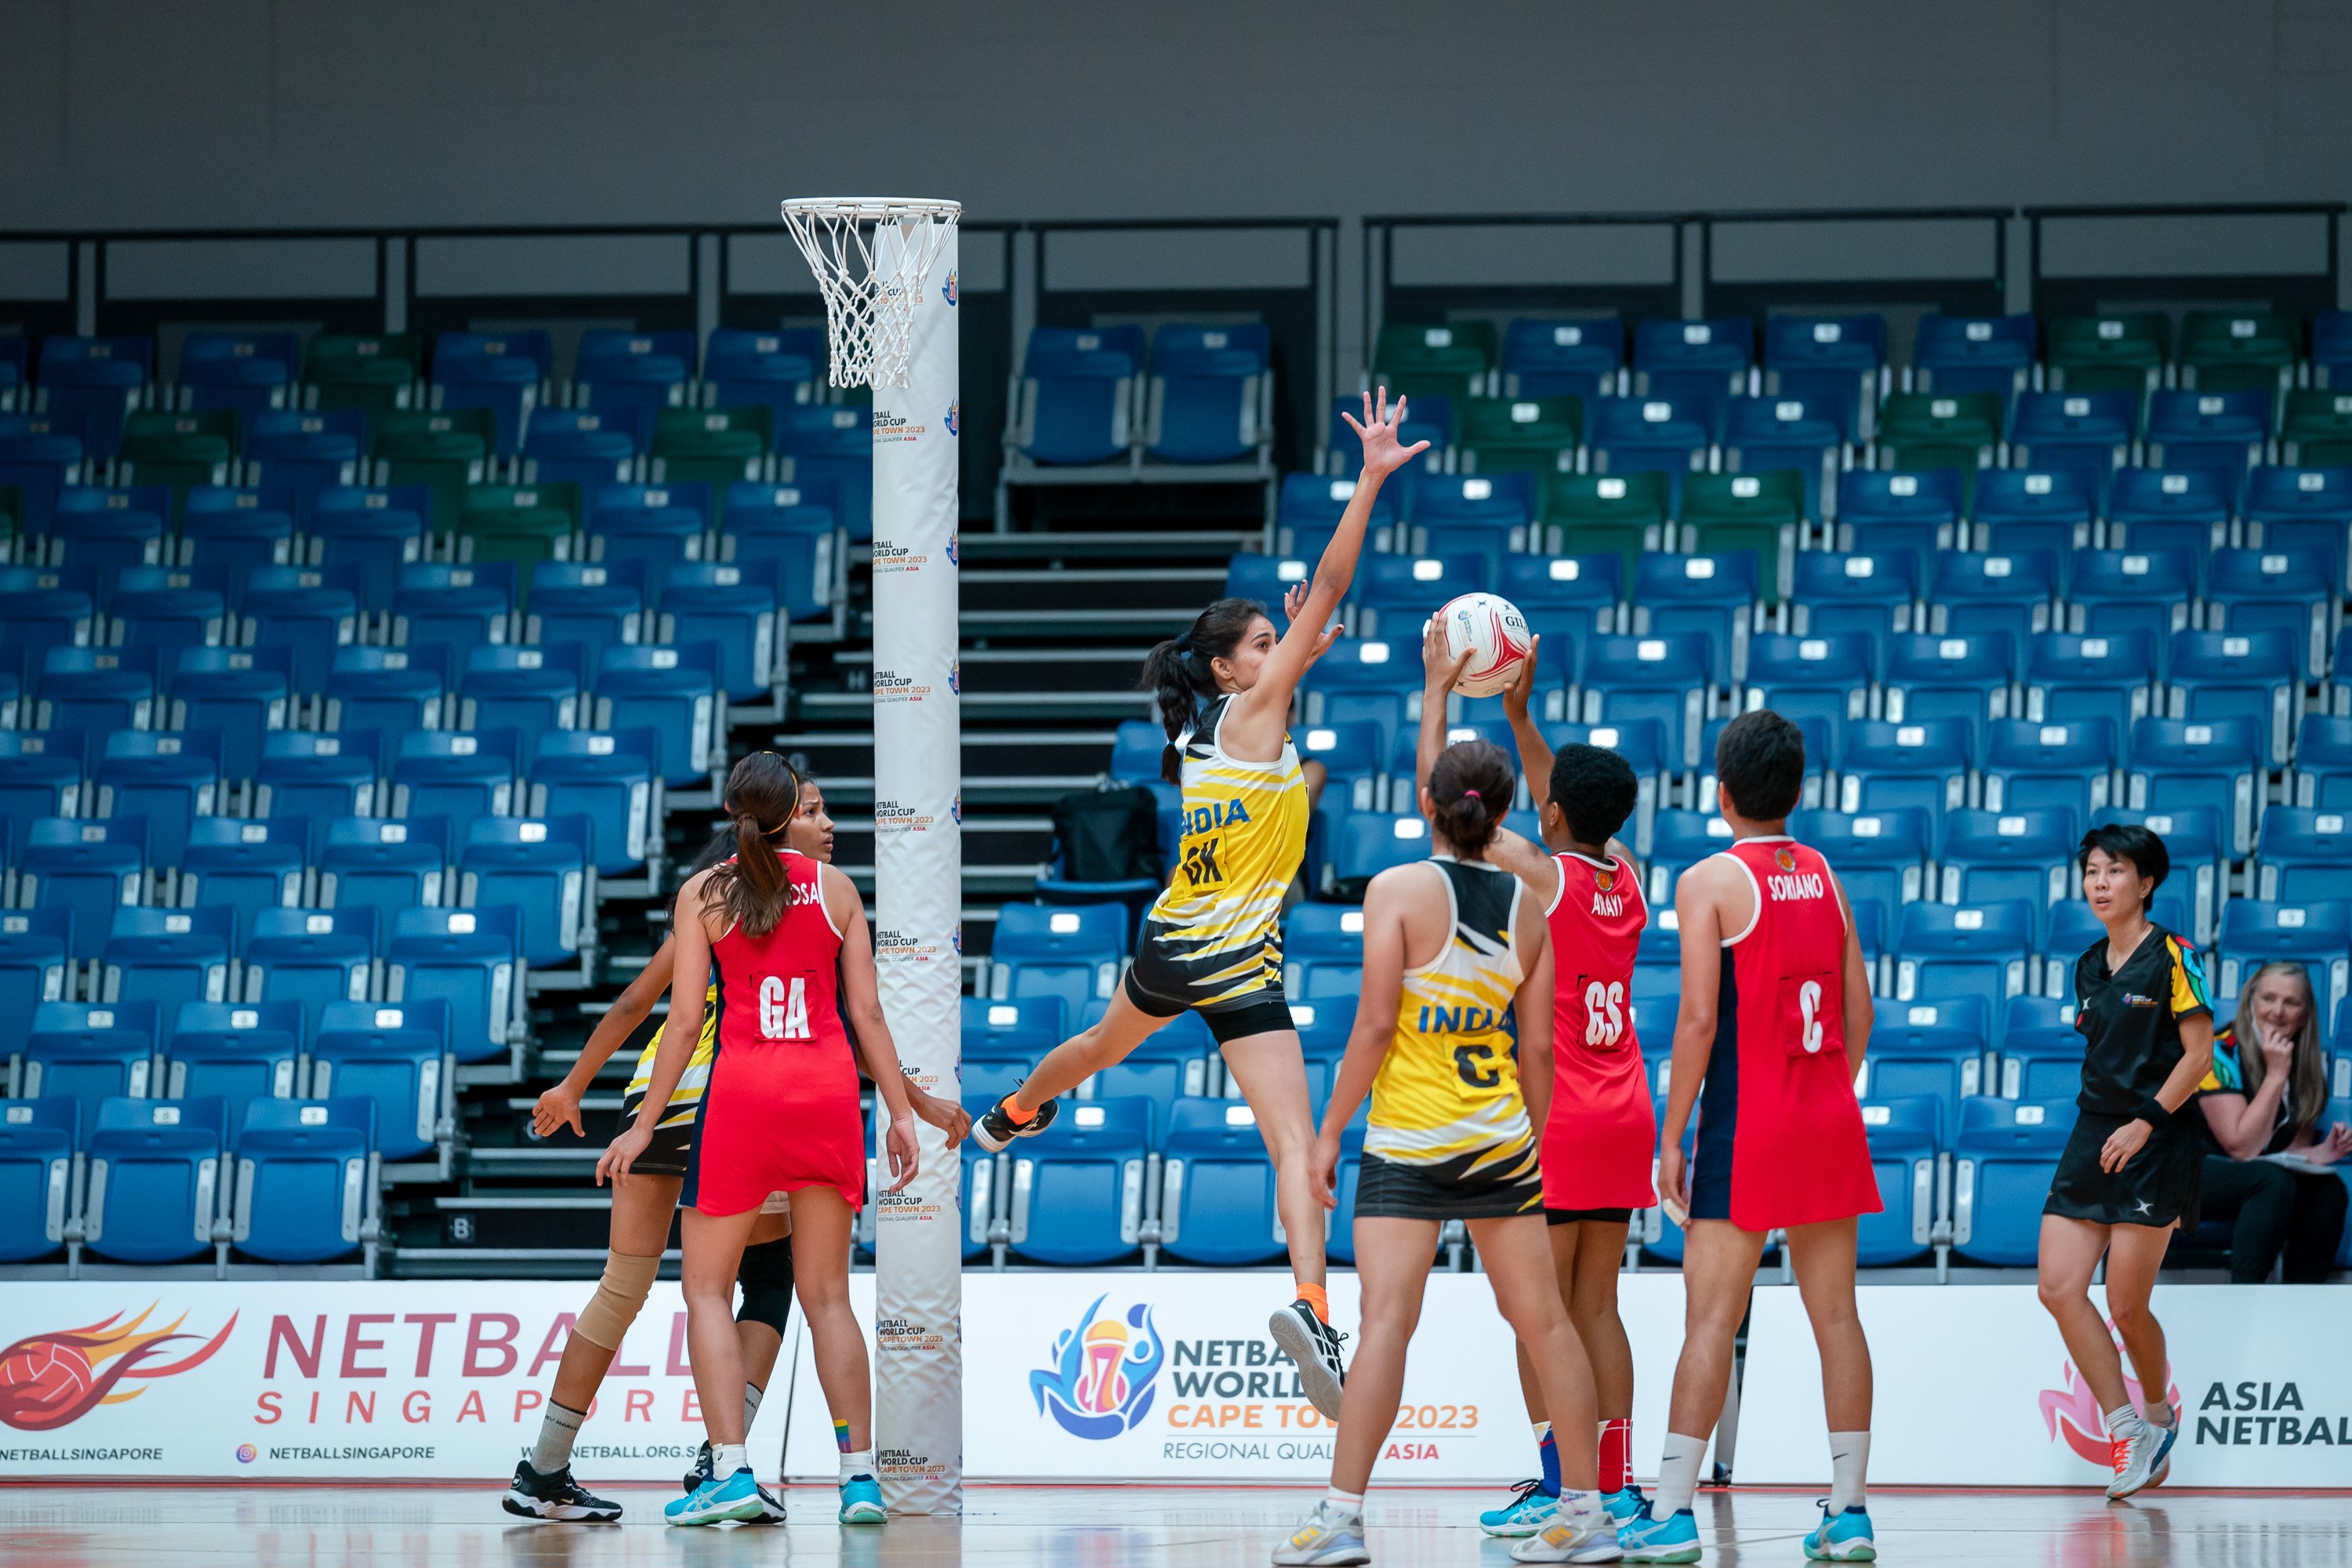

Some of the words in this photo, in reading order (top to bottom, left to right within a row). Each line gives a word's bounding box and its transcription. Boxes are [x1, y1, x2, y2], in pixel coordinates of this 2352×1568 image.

[1182, 798, 1250, 836] NDIA
[1181, 837, 1223, 886] GK
[1767, 873, 1824, 901] SORIANO
[760, 976, 811, 1039] GA
[1584, 981, 1624, 1046] GS
[1799, 980, 1823, 1053] C
[1454, 1045, 1500, 1087] C
[454, 1218, 469, 1239] B
[1173, 1340, 1295, 1367] NETBA
[2199, 1381, 2304, 1411] ASIA
[1167, 1404, 1263, 1428] CAPE
[1396, 1404, 1479, 1429] 2023
[0, 1448, 162, 1460] NETBALLSINGAPORE
[270, 1446, 434, 1459] NETBALLSINGAPORE
[1163, 1443, 1270, 1459] REGIONAL
[1385, 1443, 1439, 1460] ASIA
